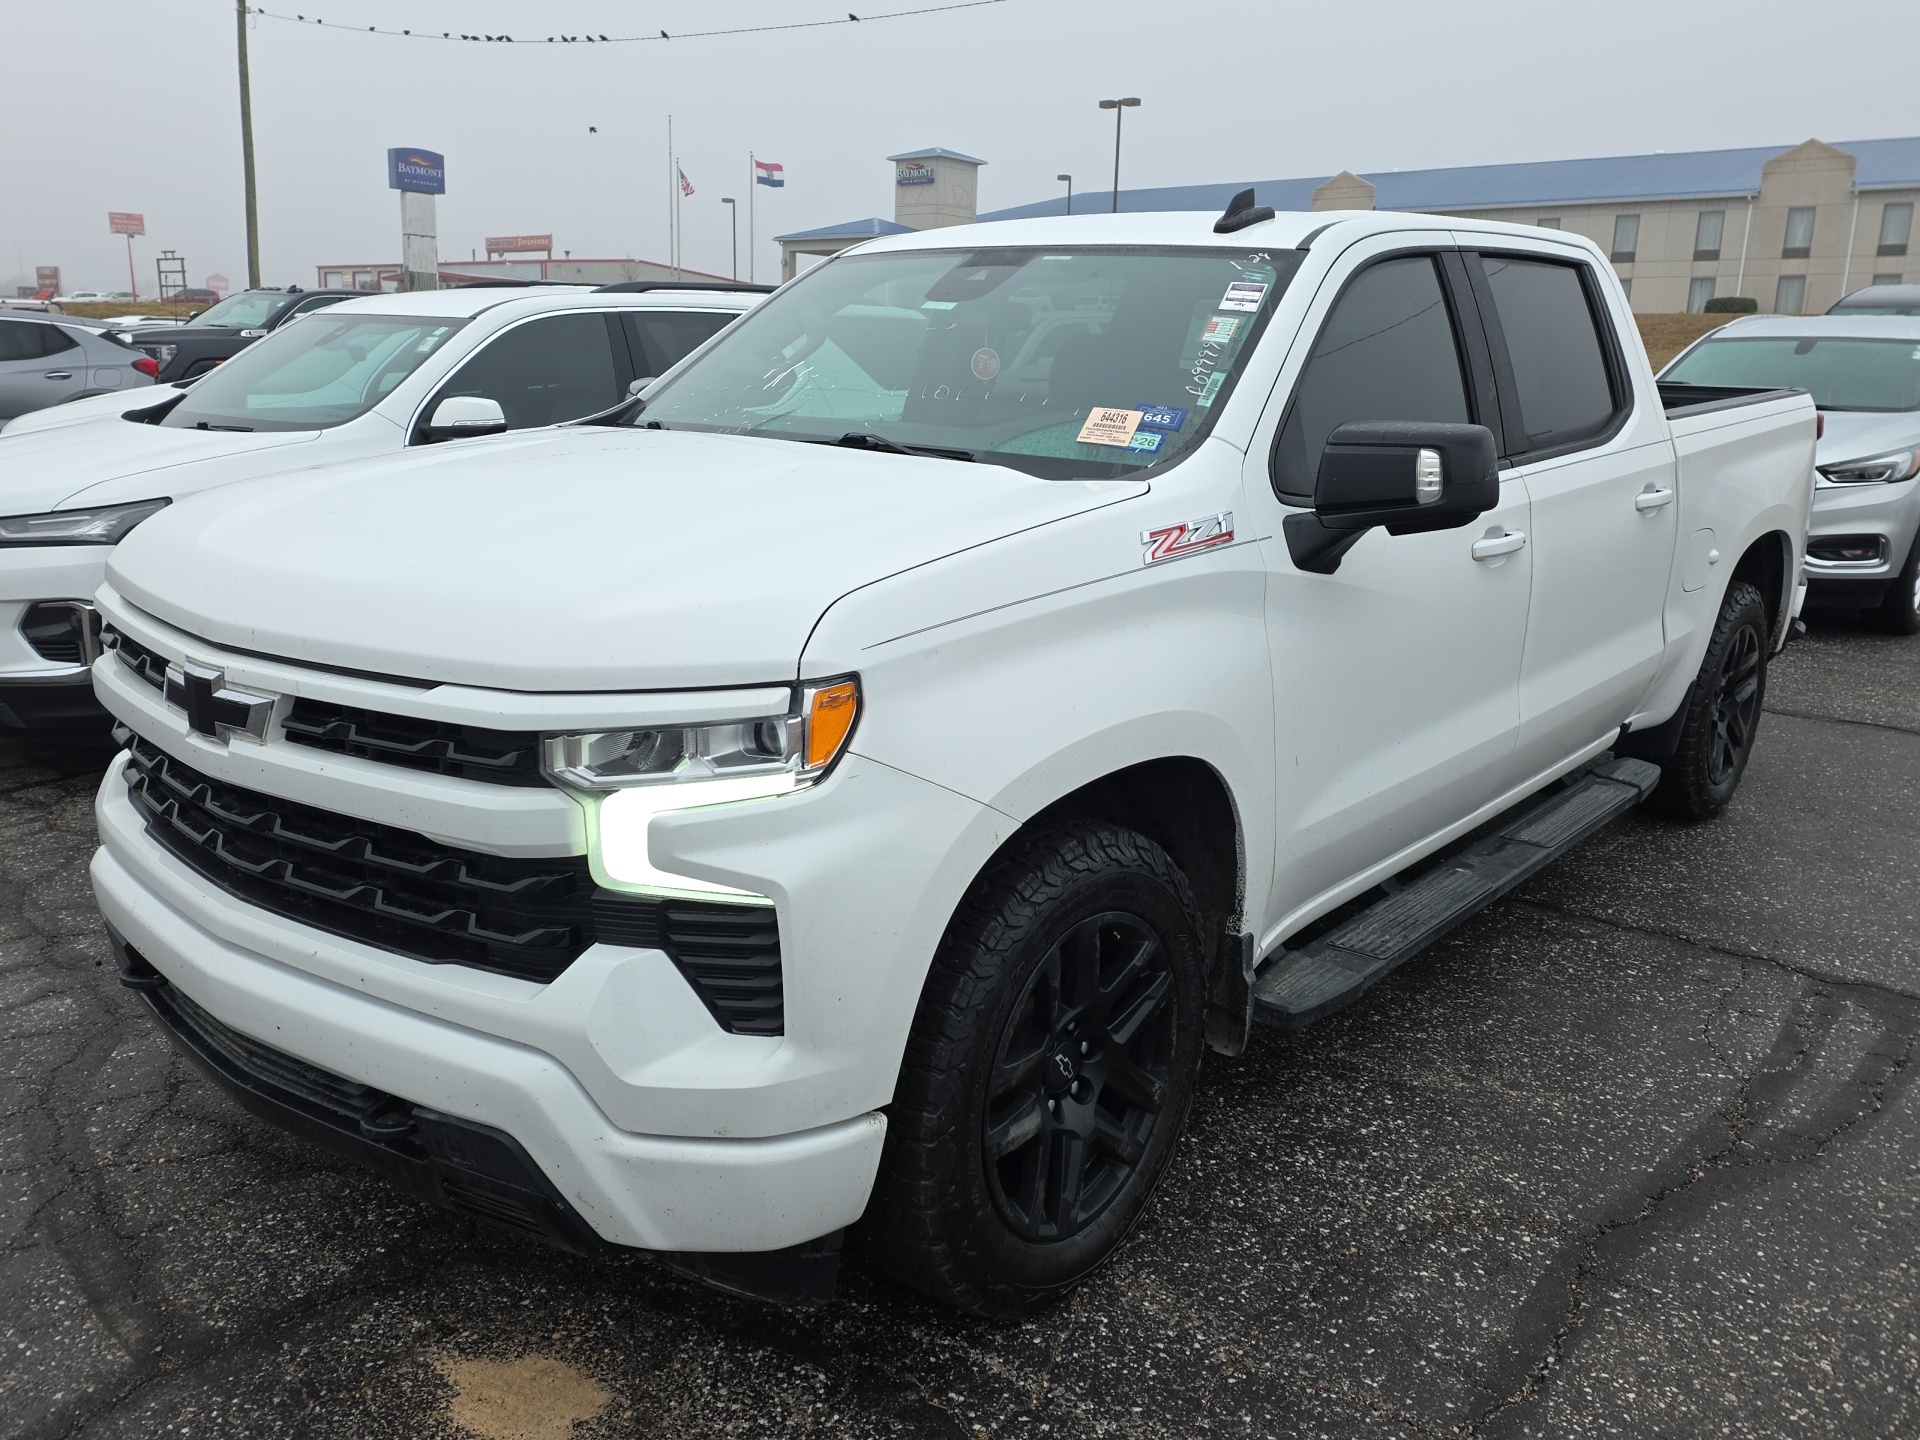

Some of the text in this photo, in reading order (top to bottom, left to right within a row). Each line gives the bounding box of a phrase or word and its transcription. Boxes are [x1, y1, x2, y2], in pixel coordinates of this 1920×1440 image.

[398, 162, 443, 178] BAYMONT
[897, 168, 932, 178] BAYMONT
[518, 238, 550, 246] Firestone
[1100, 411, 1129, 424] 644316
[1143, 413, 1172, 424] 645
[1138, 437, 1157, 447] 26
[1140, 511, 1235, 566] Z71
